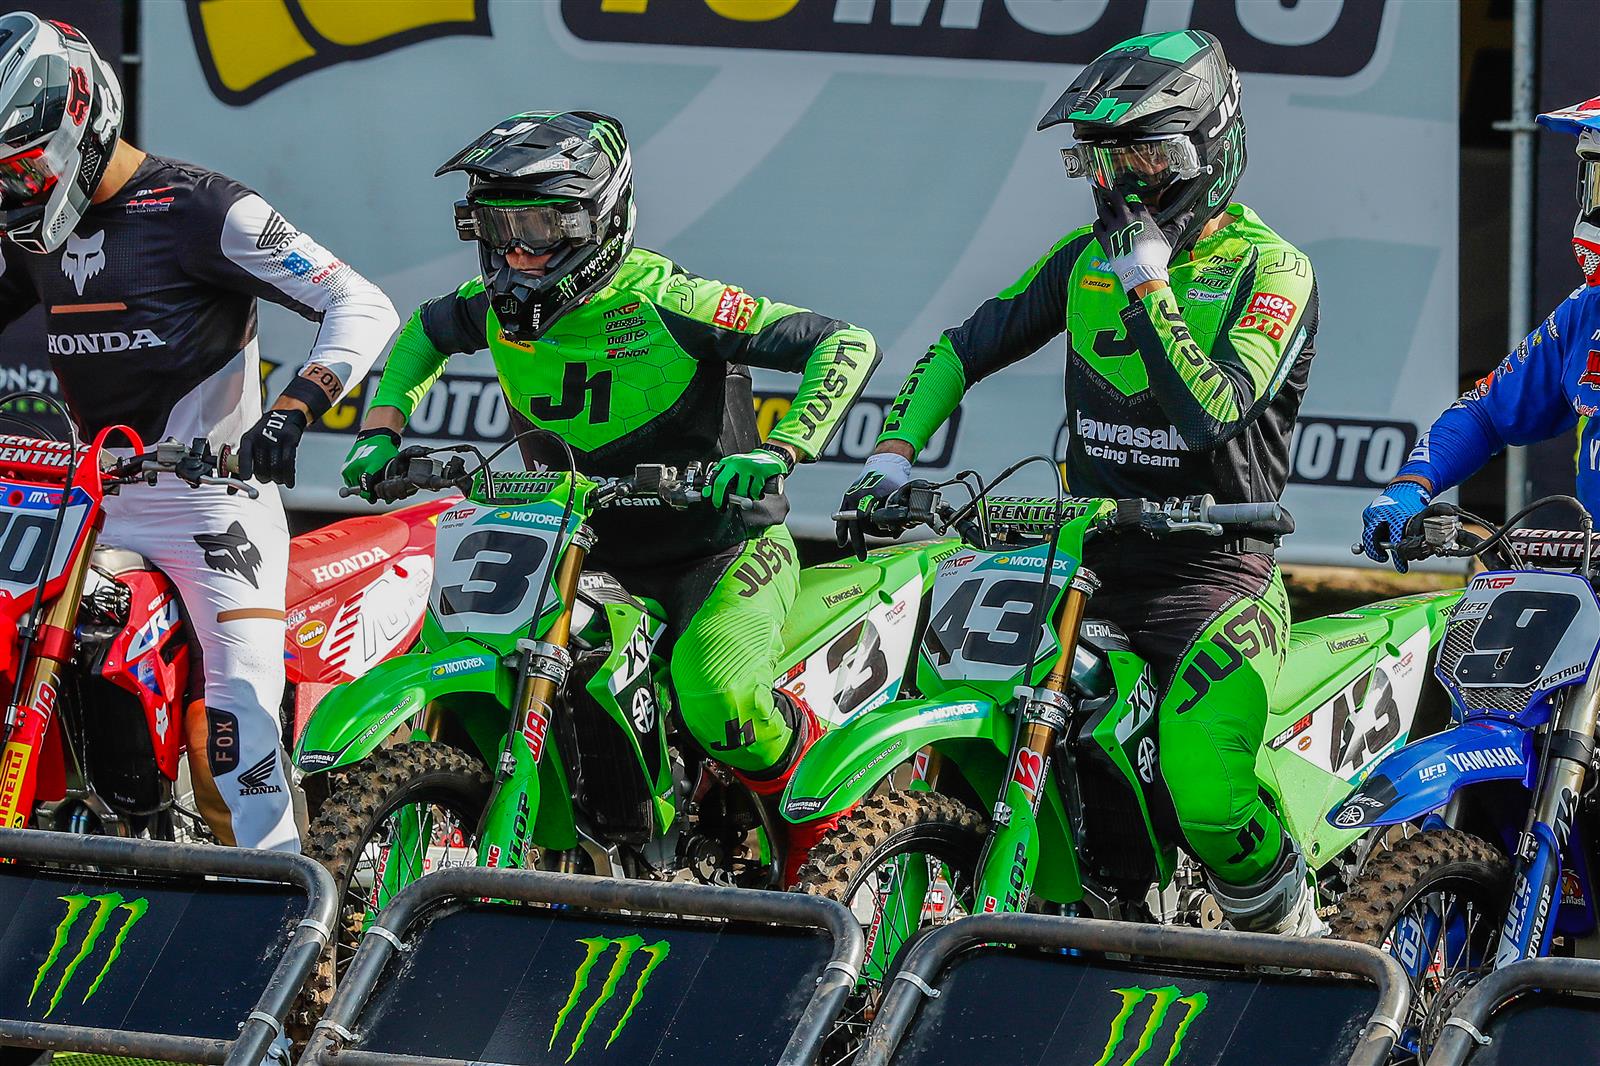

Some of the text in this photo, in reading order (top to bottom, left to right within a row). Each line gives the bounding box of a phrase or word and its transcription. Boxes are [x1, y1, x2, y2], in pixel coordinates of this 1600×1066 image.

[532, 302, 542, 330] JUST1
[716, 290, 736, 322] NGK
[1254, 294, 1293, 317] NGK
[48, 329, 166, 355] HONDA
[308, 365, 342, 400] FOX
[799, 339, 867, 441] JUST1
[260, 410, 289, 444] FOX
[1130, 449, 1180, 468] Team
[442, 508, 477, 522] MXGP
[511, 511, 573, 528] MOTORE
[311, 547, 391, 583] HONDA
[440, 530, 548, 615] 3
[941, 555, 976, 570] MXGP
[578, 575, 605, 589] CRM
[1471, 577, 1516, 591] MXGP
[826, 585, 863, 606] Kawasaki
[1460, 602, 1488, 612] UFO
[924, 577, 1062, 667] 43
[1086, 624, 1111, 637] CRM
[1330, 633, 1369, 652] Kawasaki
[1453, 590, 1581, 688] 9
[444, 657, 485, 674] MOTOREX
[826, 619, 889, 715] 3
[1541, 662, 1586, 688] PETROV
[359, 695, 412, 744] PRO CIRCUIT
[215, 719, 233, 763] FOX
[300, 753, 335, 764] Kawasaki
[846, 740, 902, 788] PRO CIRCUIT
[1446, 746, 1523, 772] YAMAHA
[1418, 762, 1447, 781] UFO
[239, 784, 282, 797] HONDA
[786, 801, 821, 812] Kawasaki
